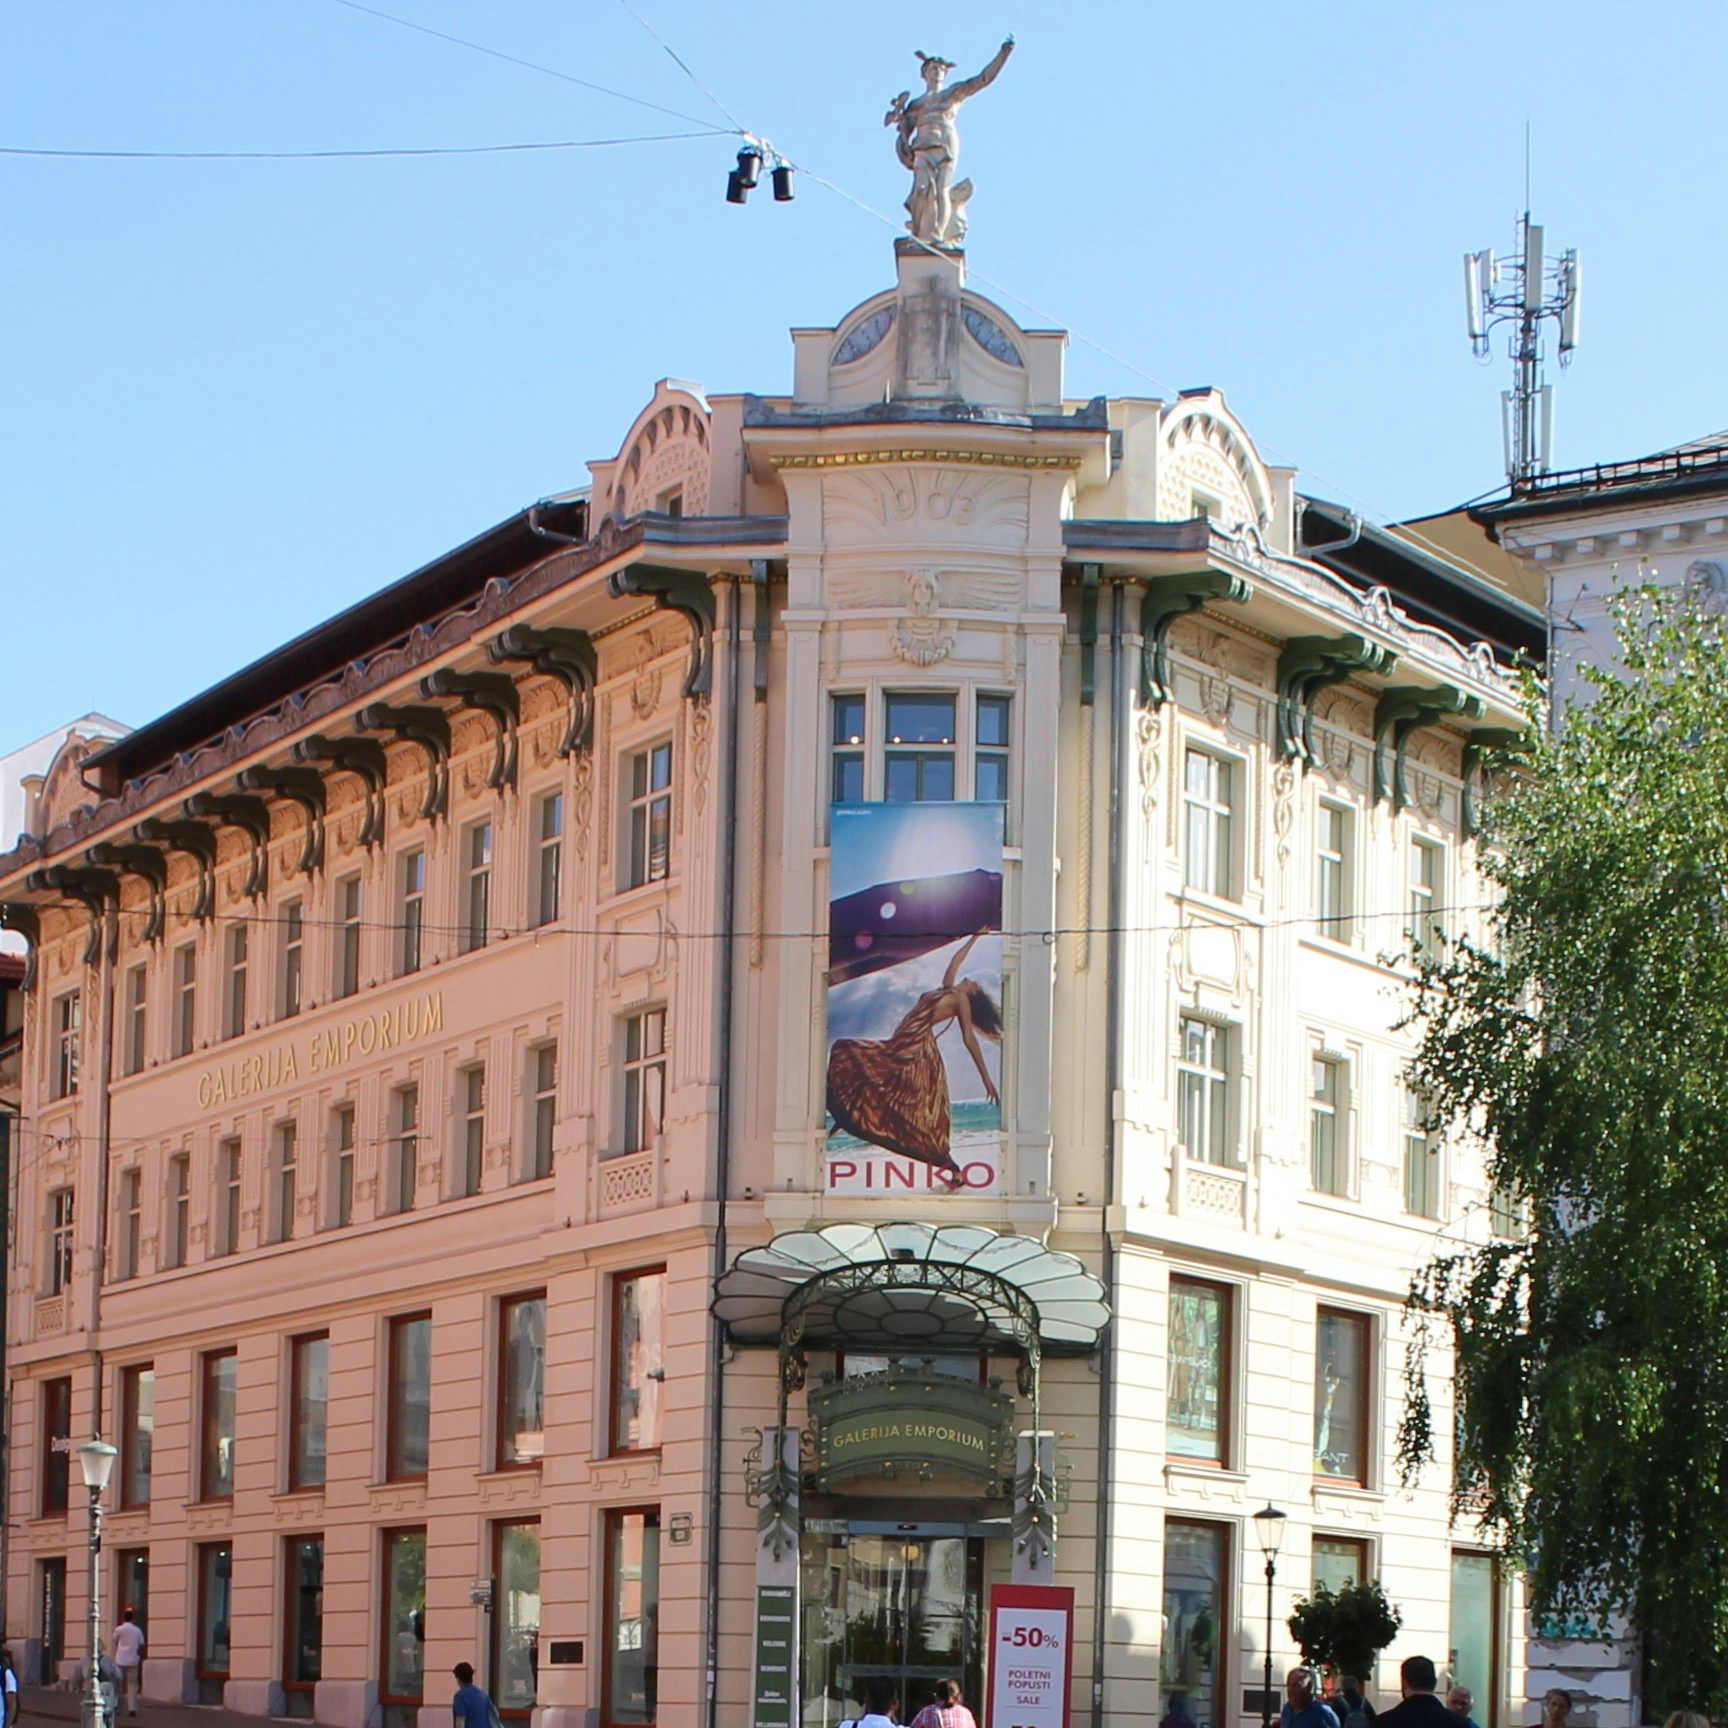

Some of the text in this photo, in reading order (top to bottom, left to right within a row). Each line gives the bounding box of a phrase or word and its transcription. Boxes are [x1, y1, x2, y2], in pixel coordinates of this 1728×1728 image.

[877, 488, 976, 527] 1903
[197, 991, 444, 1110] GALERIJA EMPORIUM
[829, 1160, 995, 1189] PINKO
[833, 1424, 984, 1450] GALERIJA EMPORIUM
[1002, 1627, 1059, 1648] -50%
[1007, 1680, 1051, 1690] POPUSTI
[1008, 1670, 1051, 1680] POLETNI
[1016, 1696, 1041, 1705] SALE
